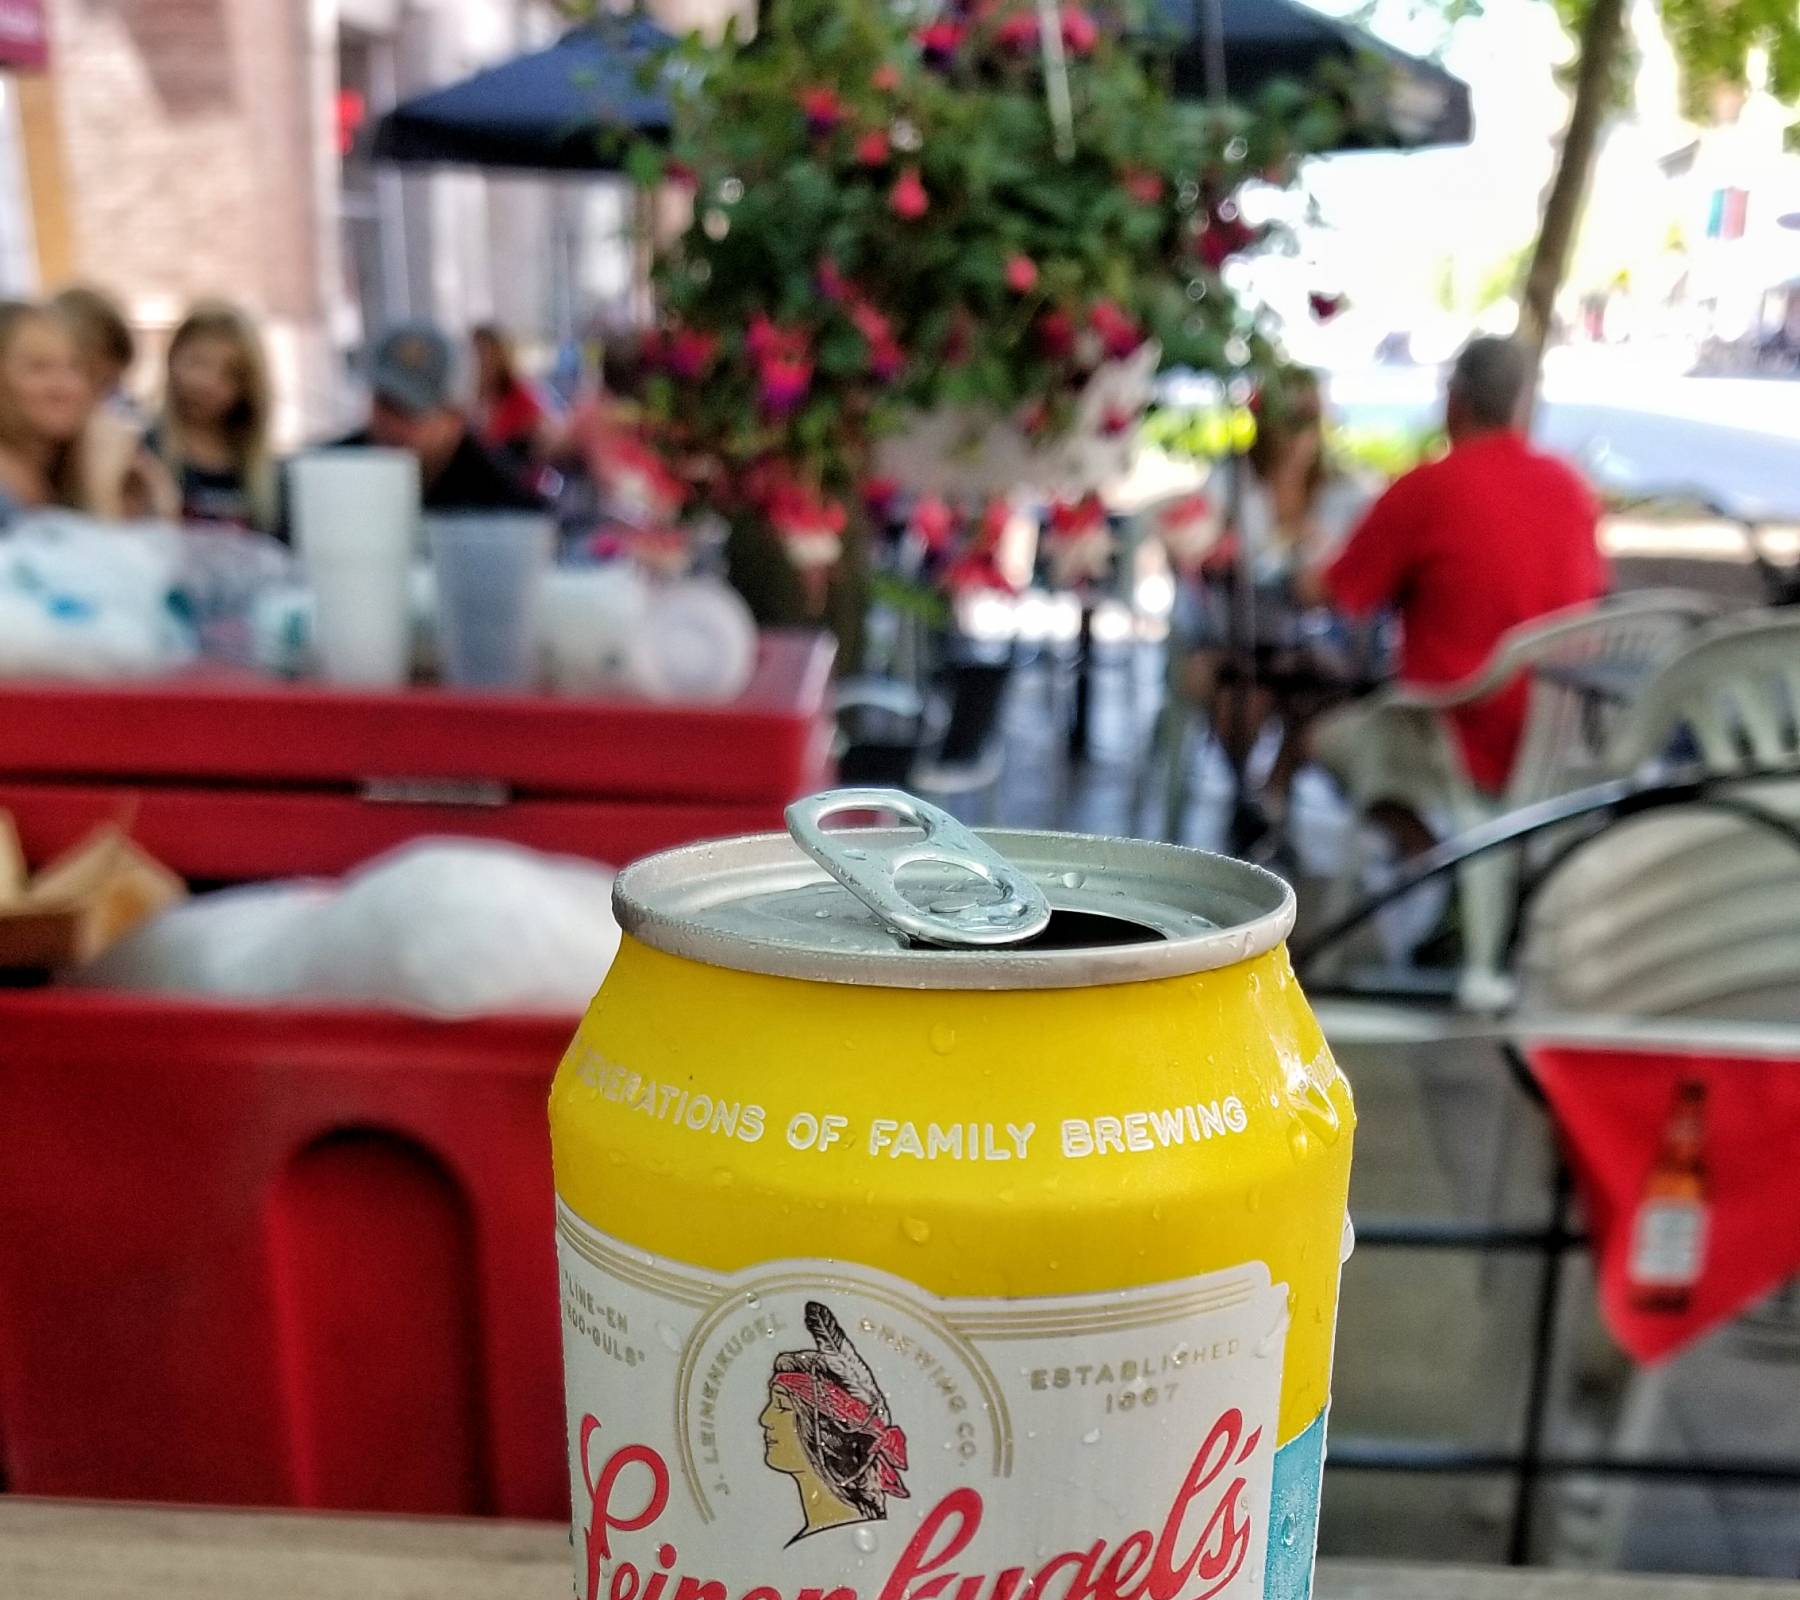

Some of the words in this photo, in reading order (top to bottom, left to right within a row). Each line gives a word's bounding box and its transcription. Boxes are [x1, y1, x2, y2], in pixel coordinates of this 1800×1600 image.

[787, 1112, 848, 1152] OF
[869, 1119, 1036, 1161] FAMILY
[1061, 1095, 1248, 1158] BREWING
